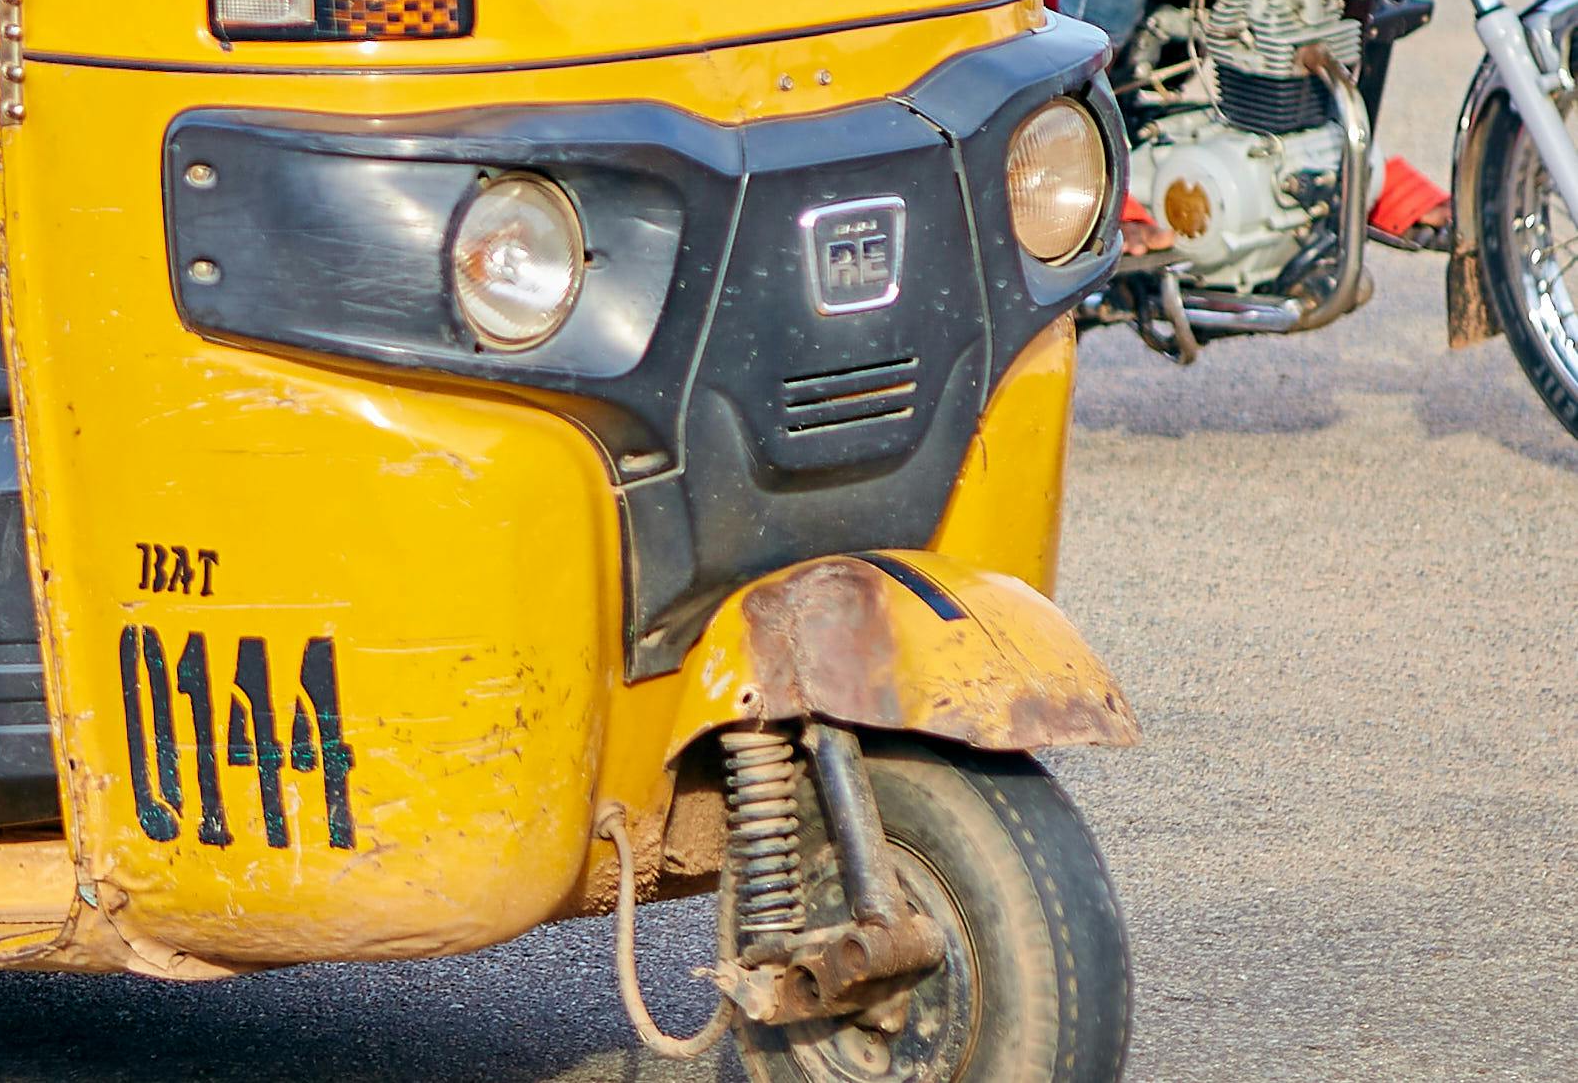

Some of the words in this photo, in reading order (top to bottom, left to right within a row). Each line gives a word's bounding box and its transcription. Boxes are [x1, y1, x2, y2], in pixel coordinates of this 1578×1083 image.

[826, 234, 889, 291] RE
[135, 543, 220, 597] BAT
[119, 624, 357, 850] 0144
